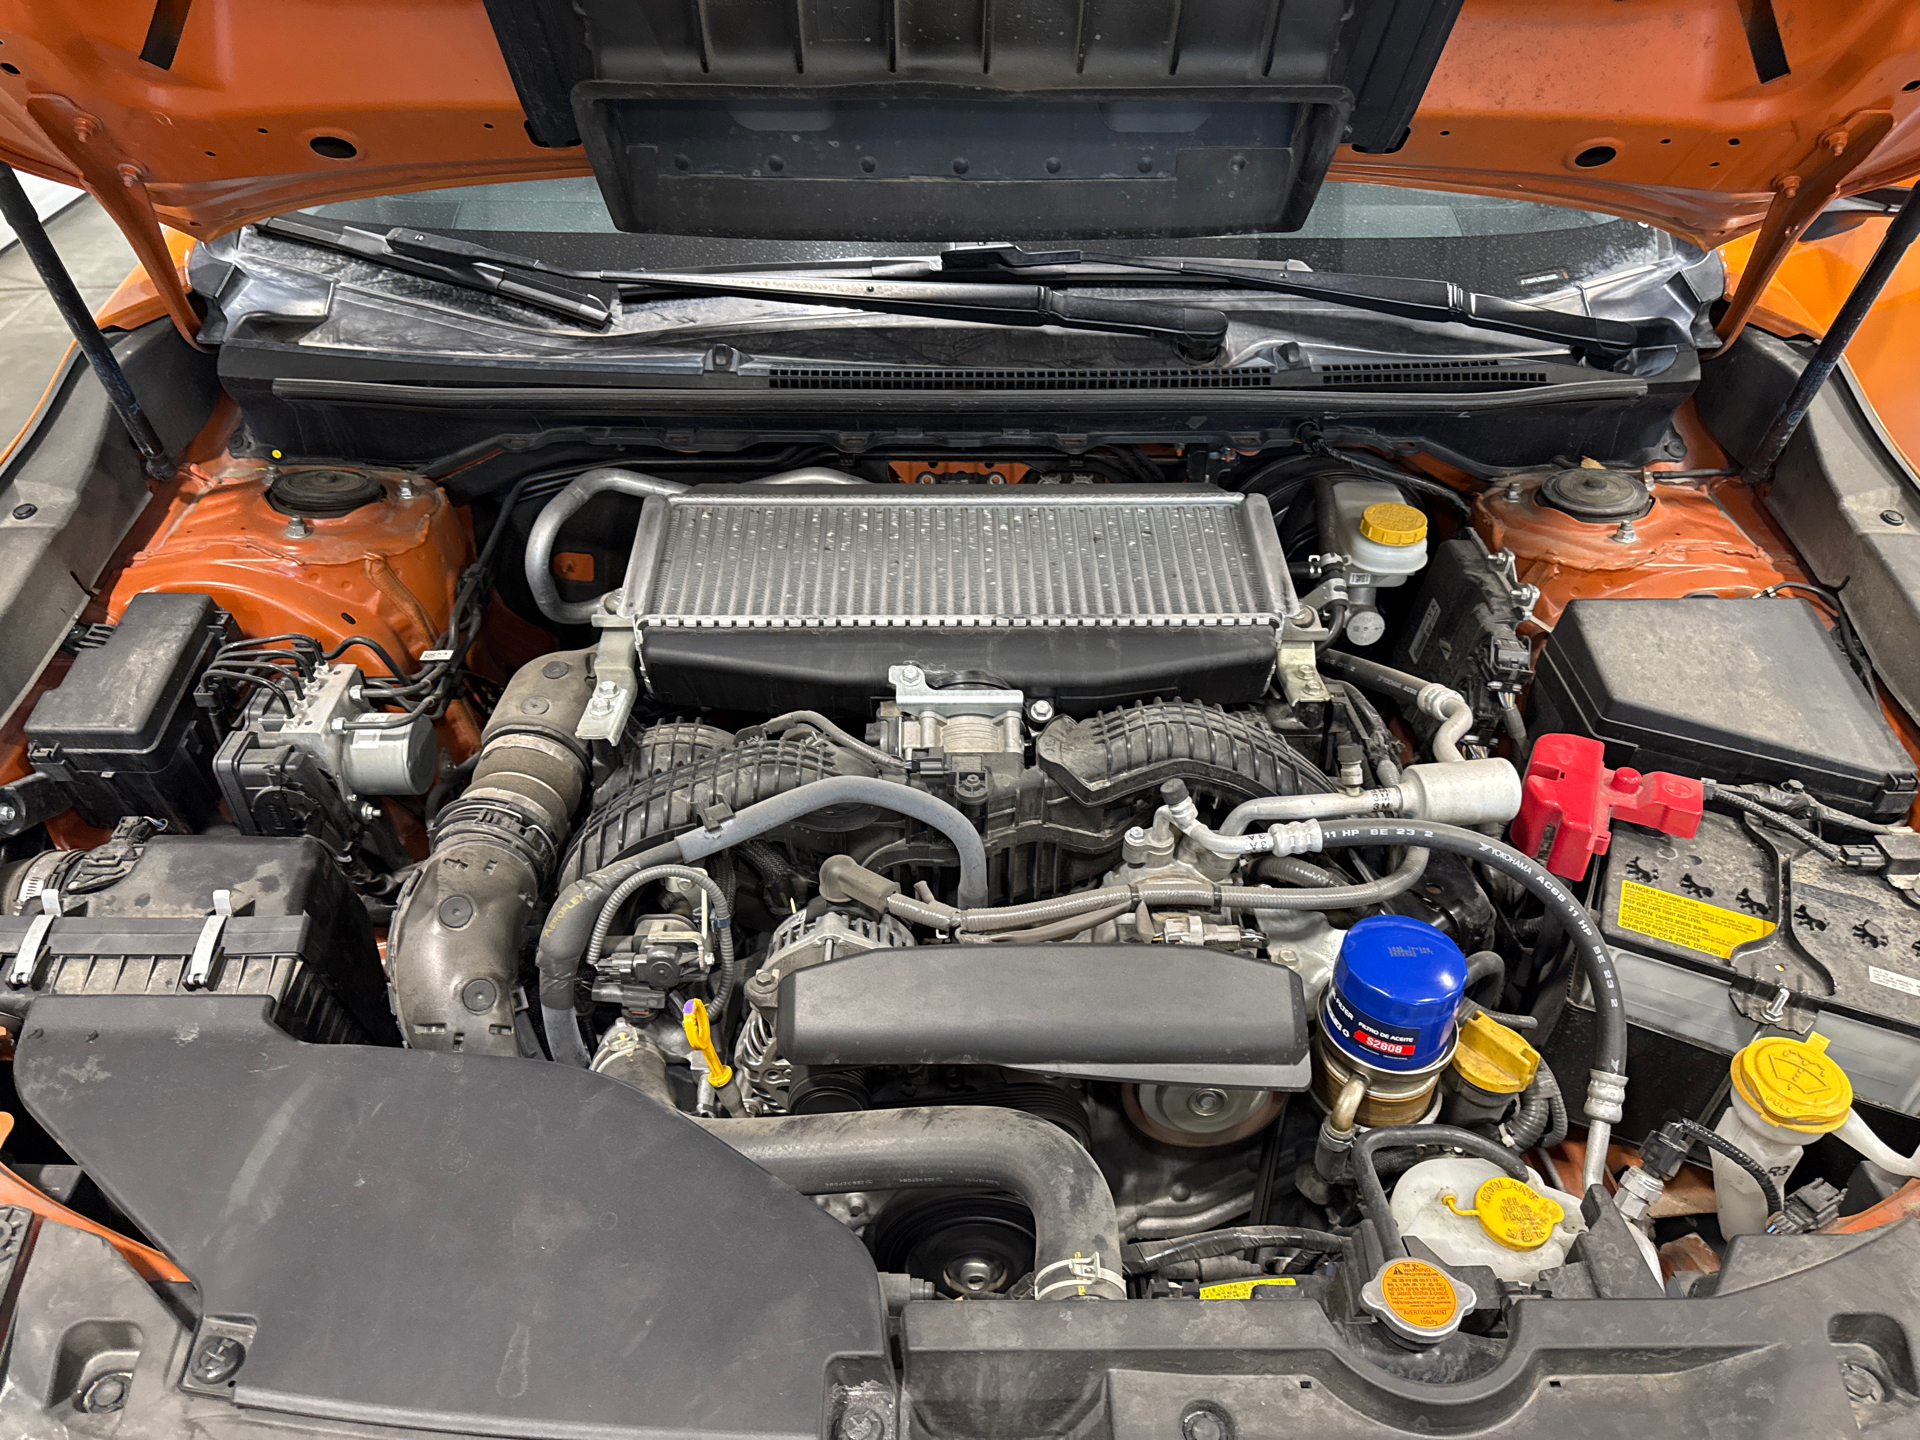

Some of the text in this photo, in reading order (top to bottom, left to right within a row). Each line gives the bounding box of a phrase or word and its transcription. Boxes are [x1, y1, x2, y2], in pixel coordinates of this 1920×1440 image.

[1625, 882, 1699, 909] DANGER EXPLOSIVE GASES
[544, 892, 587, 938] AEROFLEX
[1324, 831, 1337, 839] 11
[1342, 829, 1360, 837] HP
[1370, 828, 1388, 836] BE
[1396, 828, 1415, 836] 23
[1424, 830, 1434, 838] 2
[1490, 848, 1532, 875] YOKOHAMA
[1567, 905, 1579, 917] 11
[1578, 919, 1593, 937] HP
[1592, 945, 1606, 964] BE
[1603, 969, 1615, 989] 23
[1611, 998, 1618, 1008] 2
[1623, 897, 1636, 905] KEEP
[1636, 901, 1648, 909] VENT
[1648, 904, 1662, 913] CAPS
[1662, 909, 1676, 917] TIGHT
[1621, 915, 1634, 923] KEEP
[1651, 924, 1668, 933] REACH
[1623, 903, 1709, 934] POISON CAUSES SEVERE BURNS
[1621, 920, 1639, 930] 20HR
[1658, 932, 1674, 941] CCA
[1335, 997, 1354, 1021] FILTER
[1358, 1021, 1414, 1043] FILTRO DE ACEITE
[1366, 1036, 1403, 1054] S2808
[1765, 1095, 1792, 1114] PULL
[1480, 1180, 1539, 1202] COOLANT
